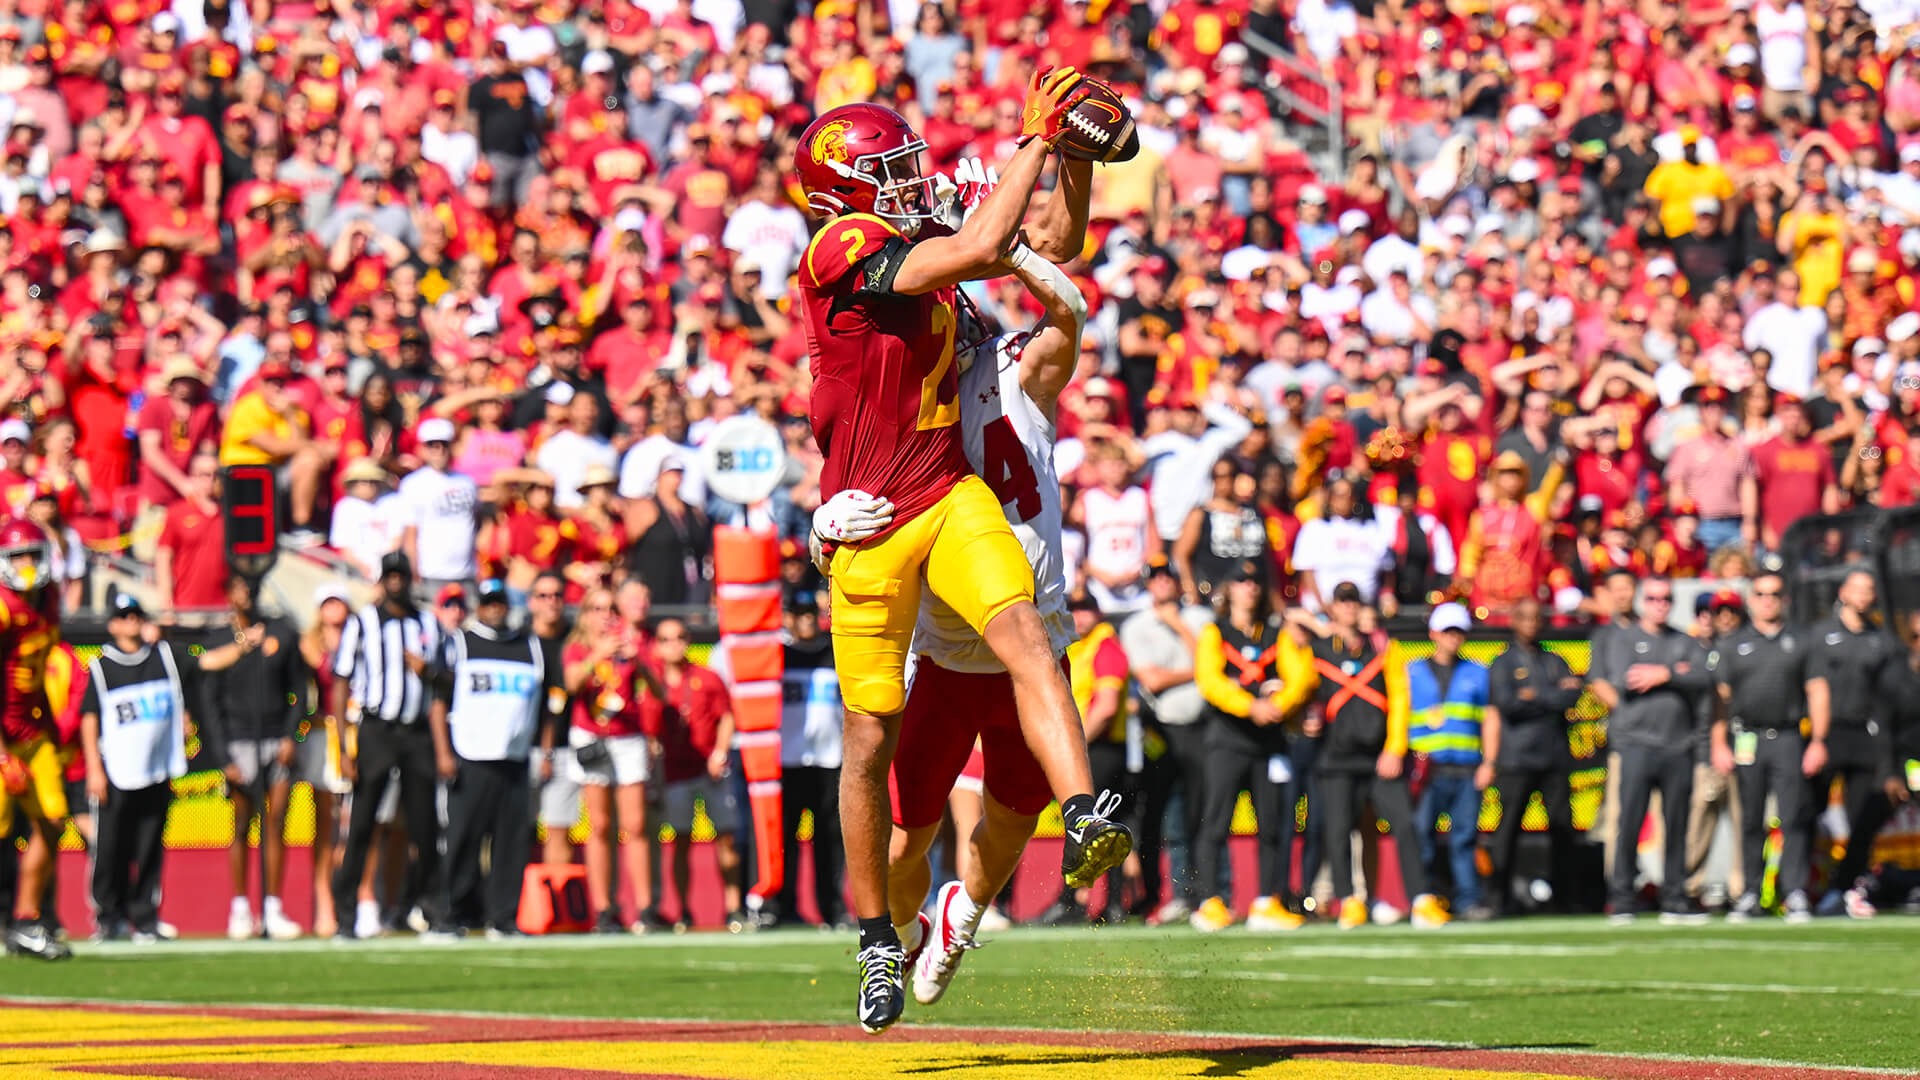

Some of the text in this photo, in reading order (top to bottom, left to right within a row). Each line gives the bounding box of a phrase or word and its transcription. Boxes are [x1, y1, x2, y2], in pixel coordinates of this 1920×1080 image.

[839, 227, 866, 266] 2
[916, 301, 960, 432] 2
[229, 466, 275, 555] 3
[983, 414, 1043, 523] 4
[543, 877, 589, 923] 10
